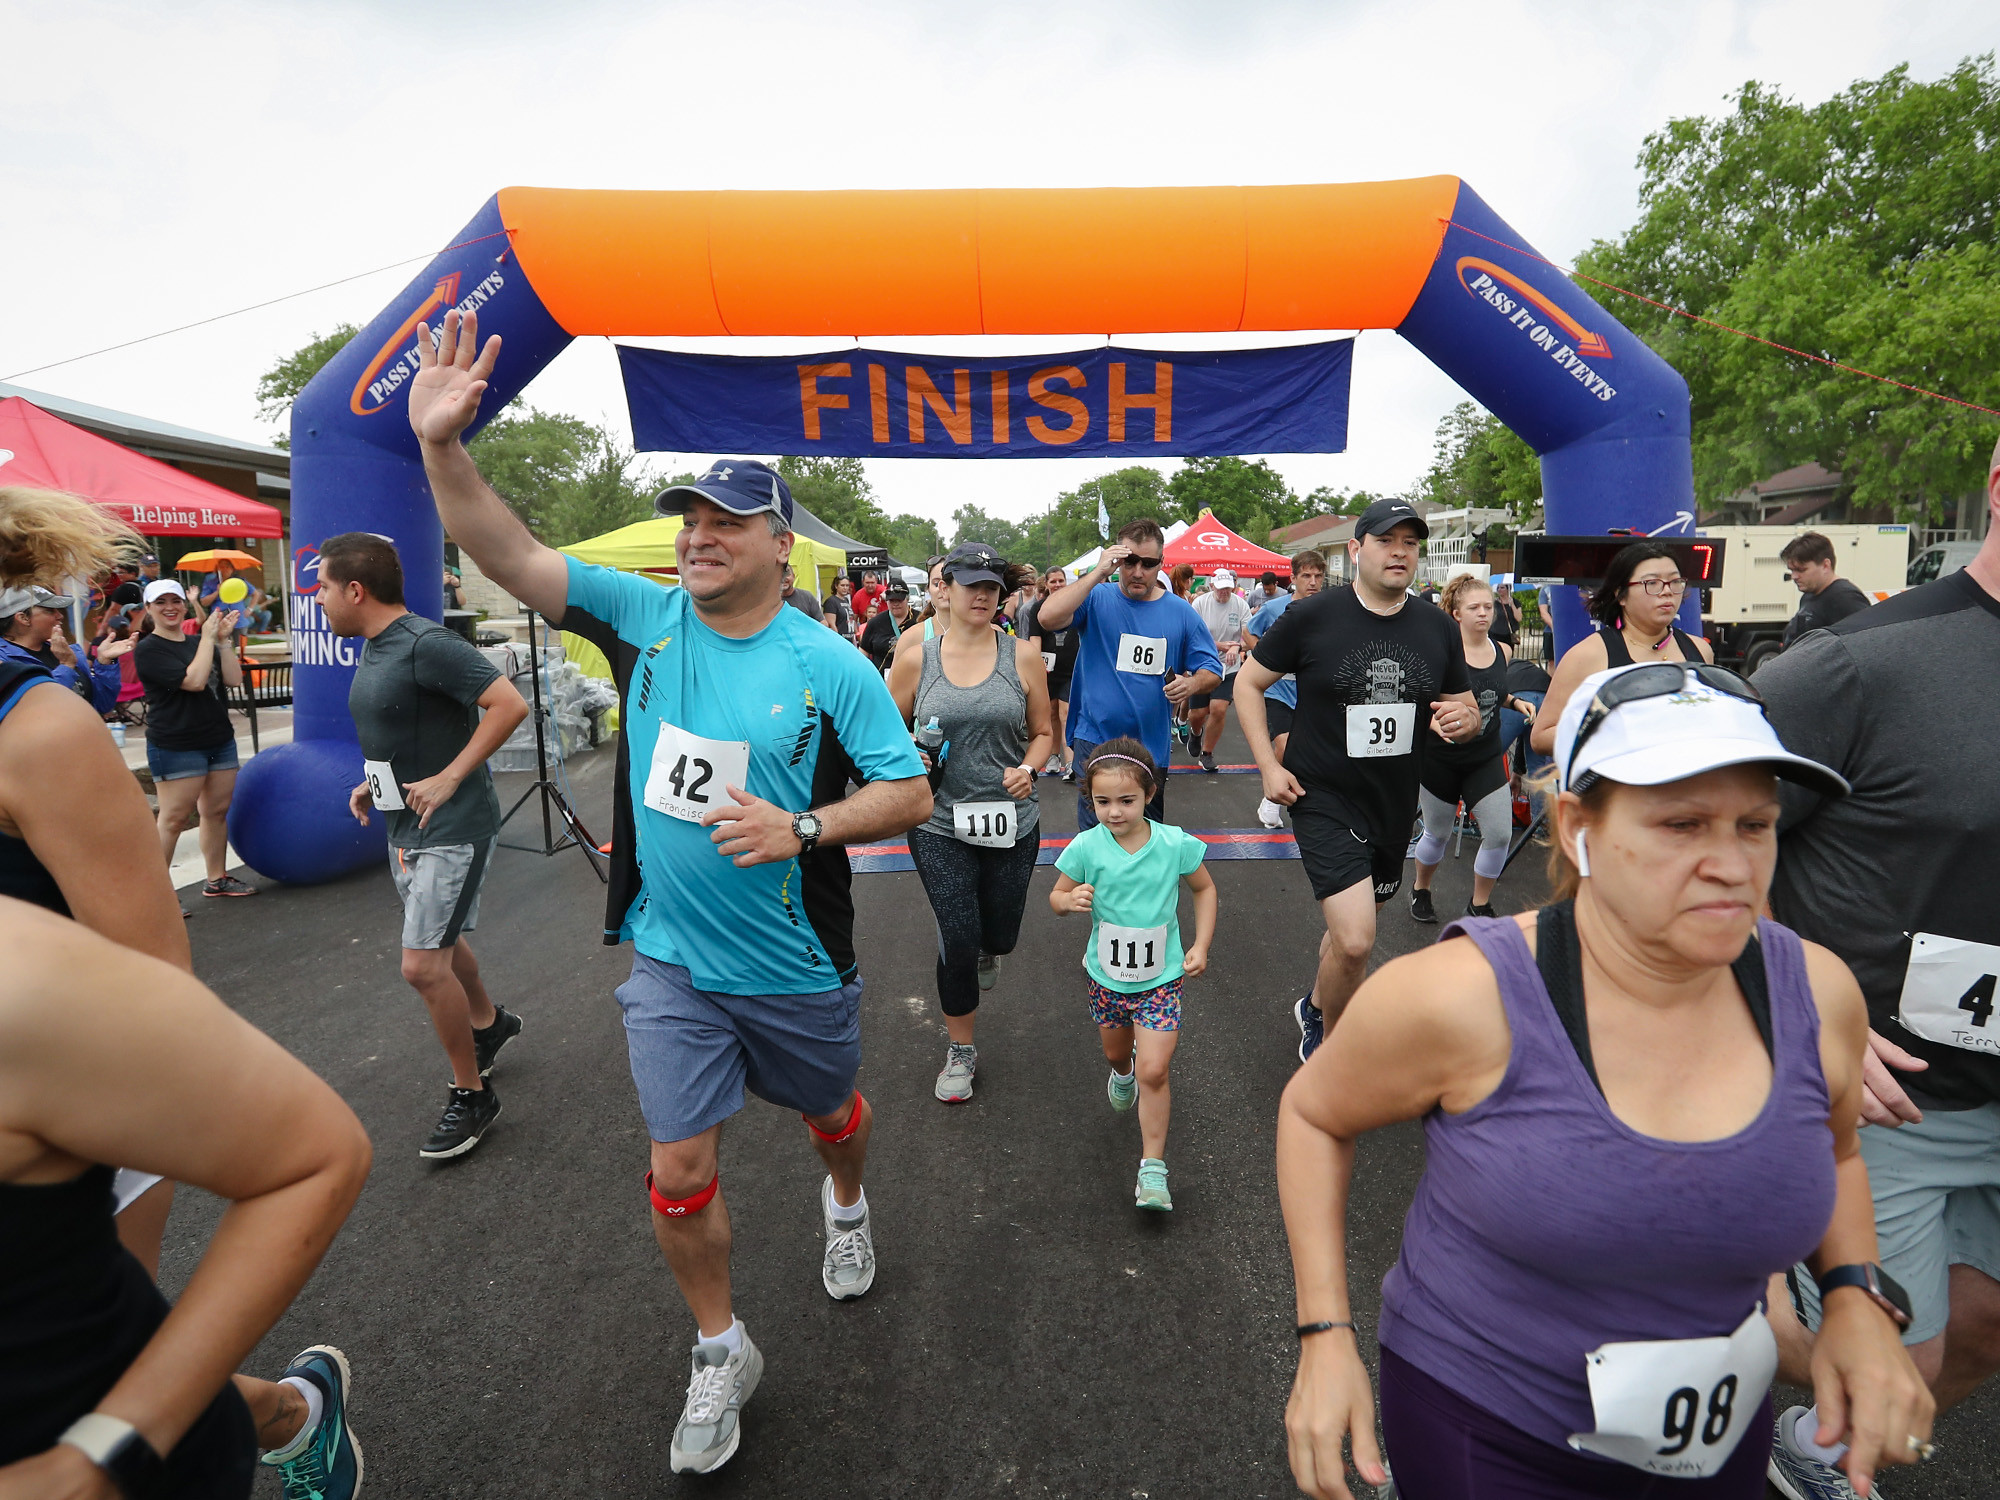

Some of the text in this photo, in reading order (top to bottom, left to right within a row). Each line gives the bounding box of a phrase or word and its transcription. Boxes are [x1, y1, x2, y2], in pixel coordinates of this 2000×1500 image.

[1469, 273, 1617, 401] PASS IT ON EVENTS
[367, 361, 411, 405] PASS
[797, 362, 1173, 446] FINISH
[132, 505, 241, 529] Helping Here.
[850, 556, 878, 566] .COM
[1182, 545, 1247, 553] CYCLEBAR
[1133, 645, 1154, 666] 86
[1373, 663, 1397, 673] NEVER
[1369, 717, 1397, 745] 39
[668, 753, 714, 804] 42
[659, 796, 707, 819] Francisc
[967, 812, 1008, 837] 110
[1110, 938, 1155, 969] 111
[1958, 973, 2000, 1028] 4
[1656, 1373, 1738, 1456] 98
